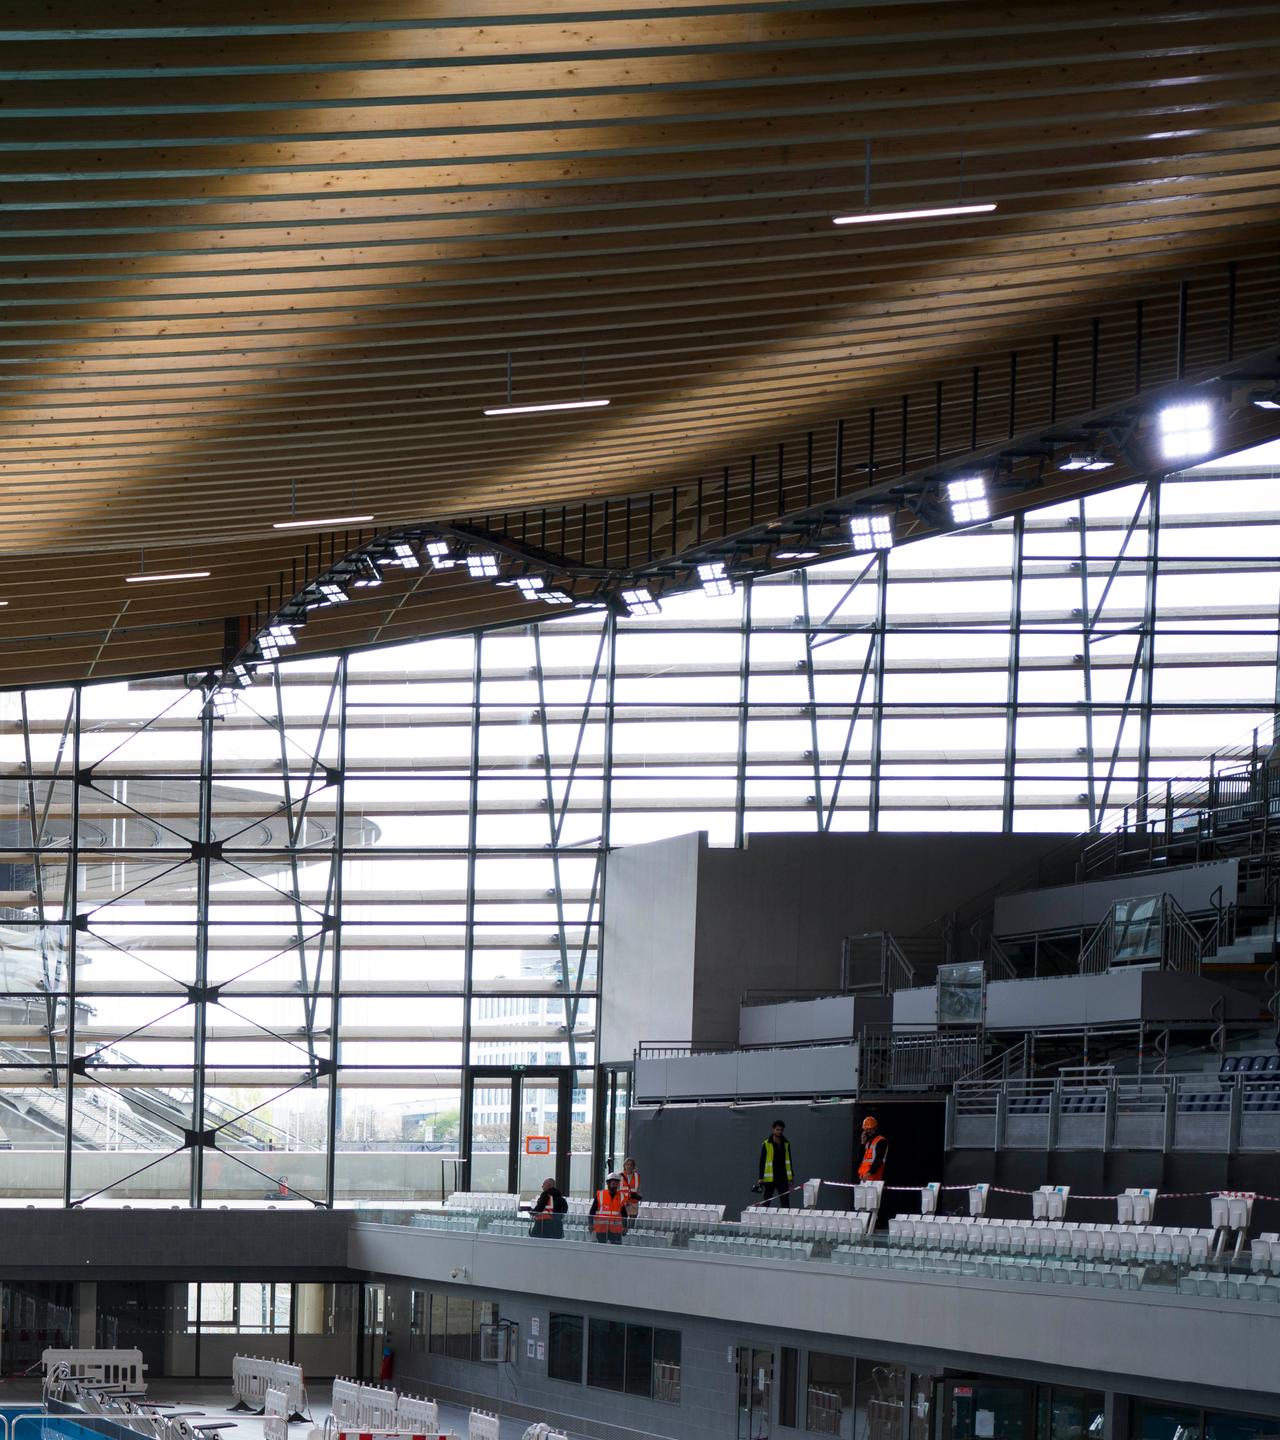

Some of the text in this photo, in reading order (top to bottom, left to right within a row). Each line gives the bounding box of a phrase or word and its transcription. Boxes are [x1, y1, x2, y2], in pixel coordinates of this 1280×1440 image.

[75, 1384, 80, 1395] 1
[98, 1392, 105, 1405] 2
[125, 1401, 132, 1414] 3
[180, 1422, 188, 1436] 5
